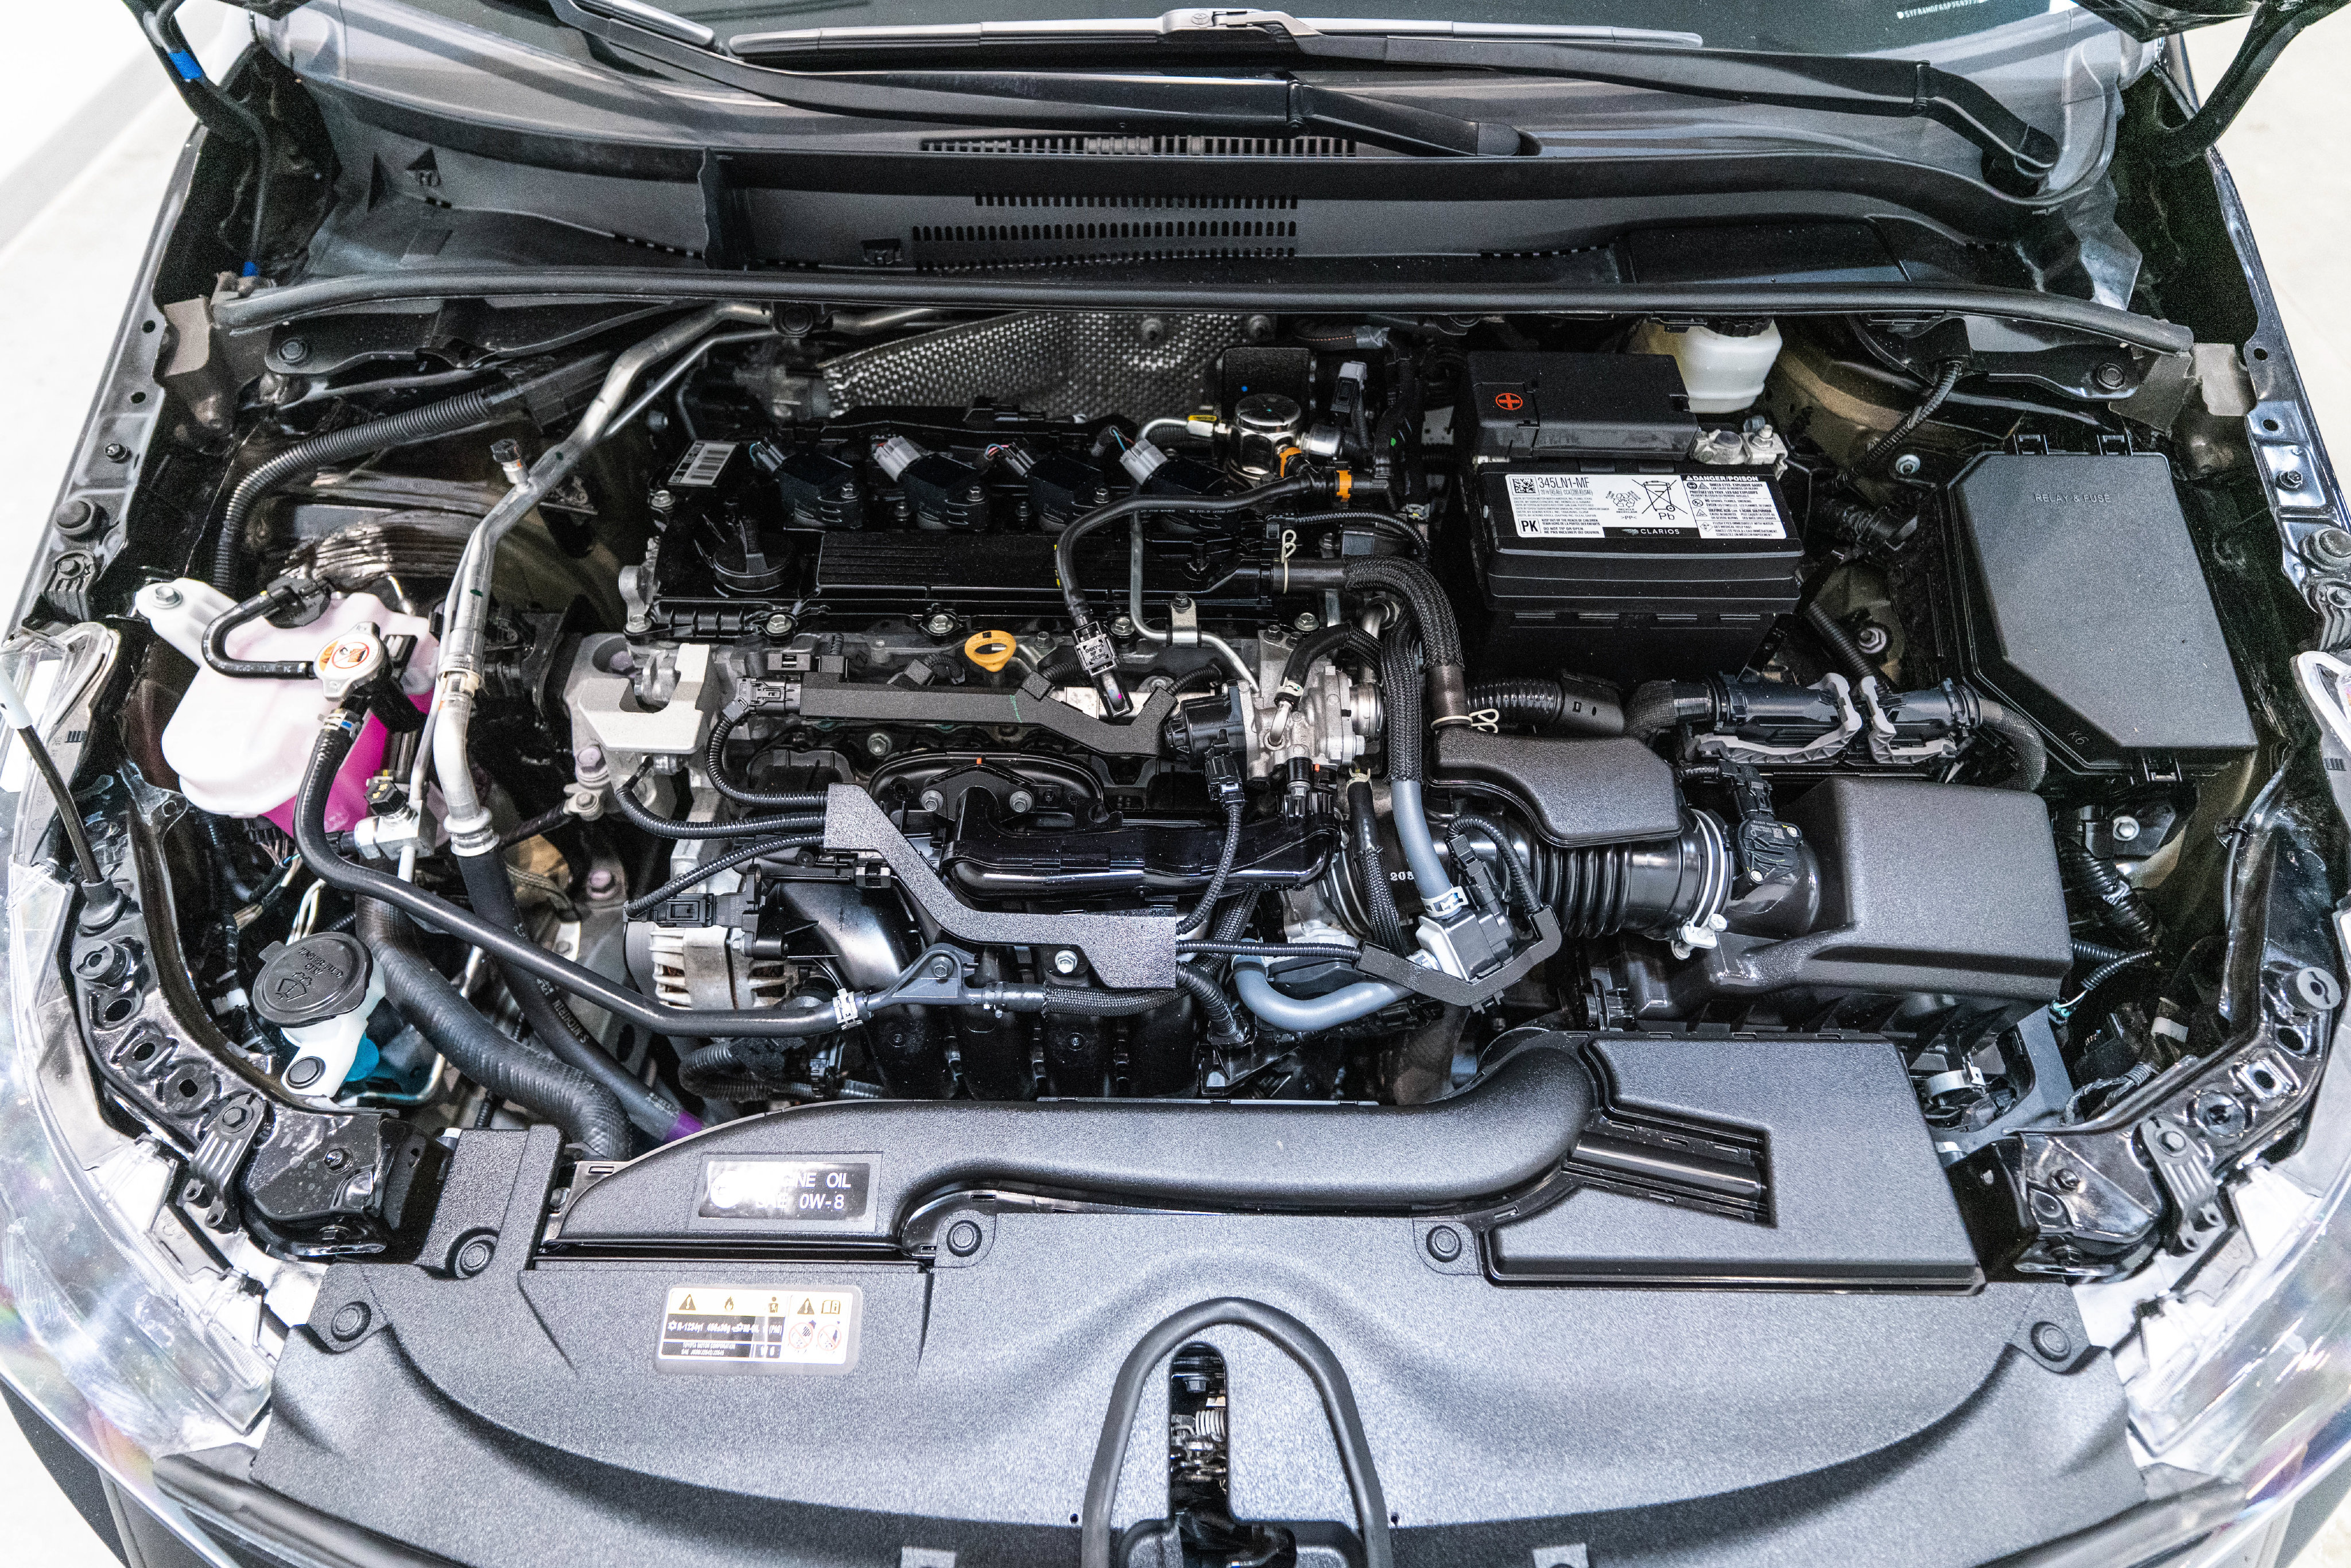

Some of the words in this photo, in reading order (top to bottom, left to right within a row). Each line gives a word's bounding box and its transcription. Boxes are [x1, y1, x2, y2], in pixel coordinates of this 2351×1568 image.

[1538, 477, 1590, 488] 345LN1-MF
[2034, 494, 2069, 503] RELAY
[2083, 494, 2111, 503] FUSE
[1521, 521, 1539, 532] PK
[298, 947, 325, 967] WASHER
[323, 964, 344, 979] FLUID
[304, 962, 323, 976] ONLY
[825, 1172, 851, 1189] OIL
[799, 1193, 844, 1210] 0W-8
